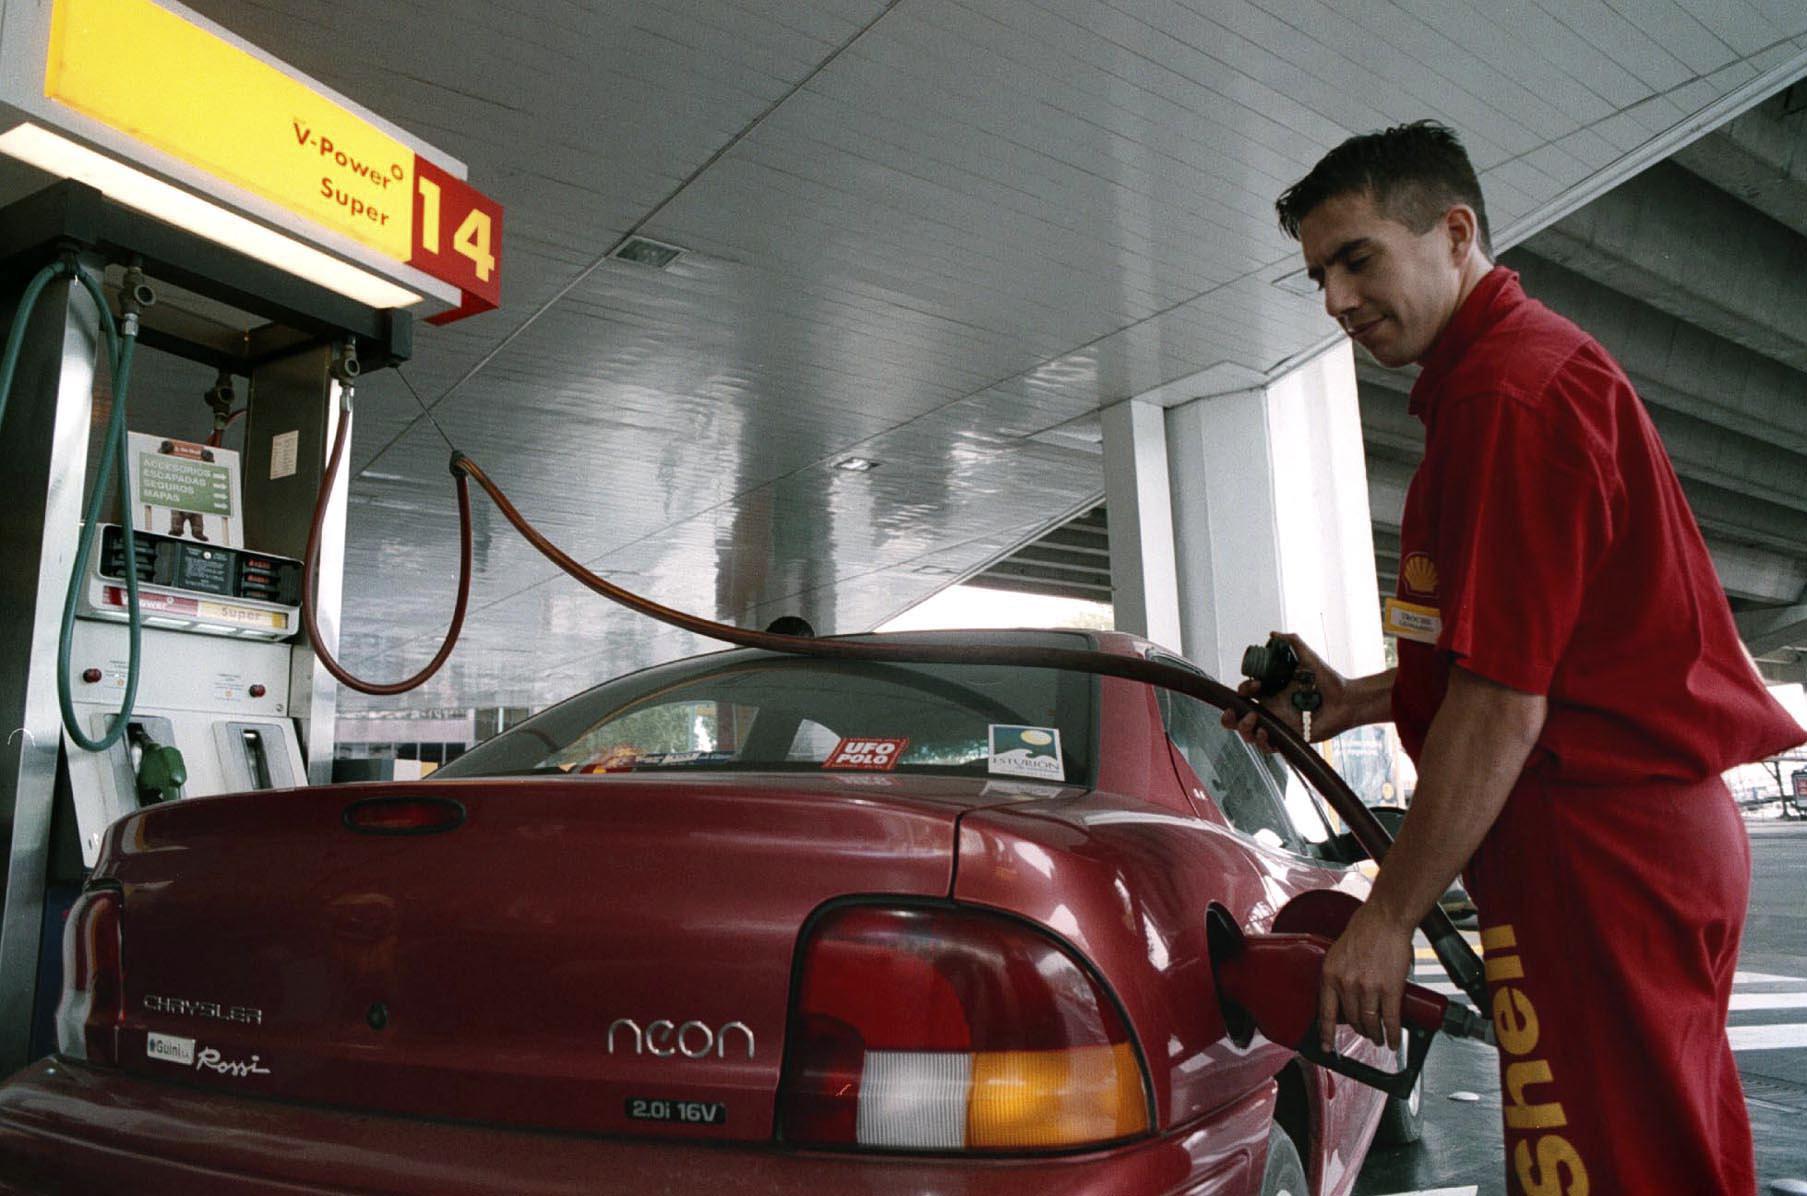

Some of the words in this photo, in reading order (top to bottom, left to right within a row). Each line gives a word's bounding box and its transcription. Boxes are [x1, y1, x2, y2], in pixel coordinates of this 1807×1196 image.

[293, 121, 392, 190] V-Power
[320, 177, 390, 226] Super
[419, 175, 495, 283] 14
[143, 479, 195, 495] SEGUROS
[143, 488, 181, 502] MAPAS
[221, 606, 261, 621] Super
[835, 753, 889, 765] POLO
[844, 742, 896, 754] UFO
[143, 994, 262, 1025] CHRYSLER
[608, 1018, 755, 1059] neon
[196, 1046, 271, 1077] Rossi
[1482, 924, 1590, 1196] Shell
[632, 1100, 671, 1119] 2.0i
[677, 1103, 718, 1122] 16V
